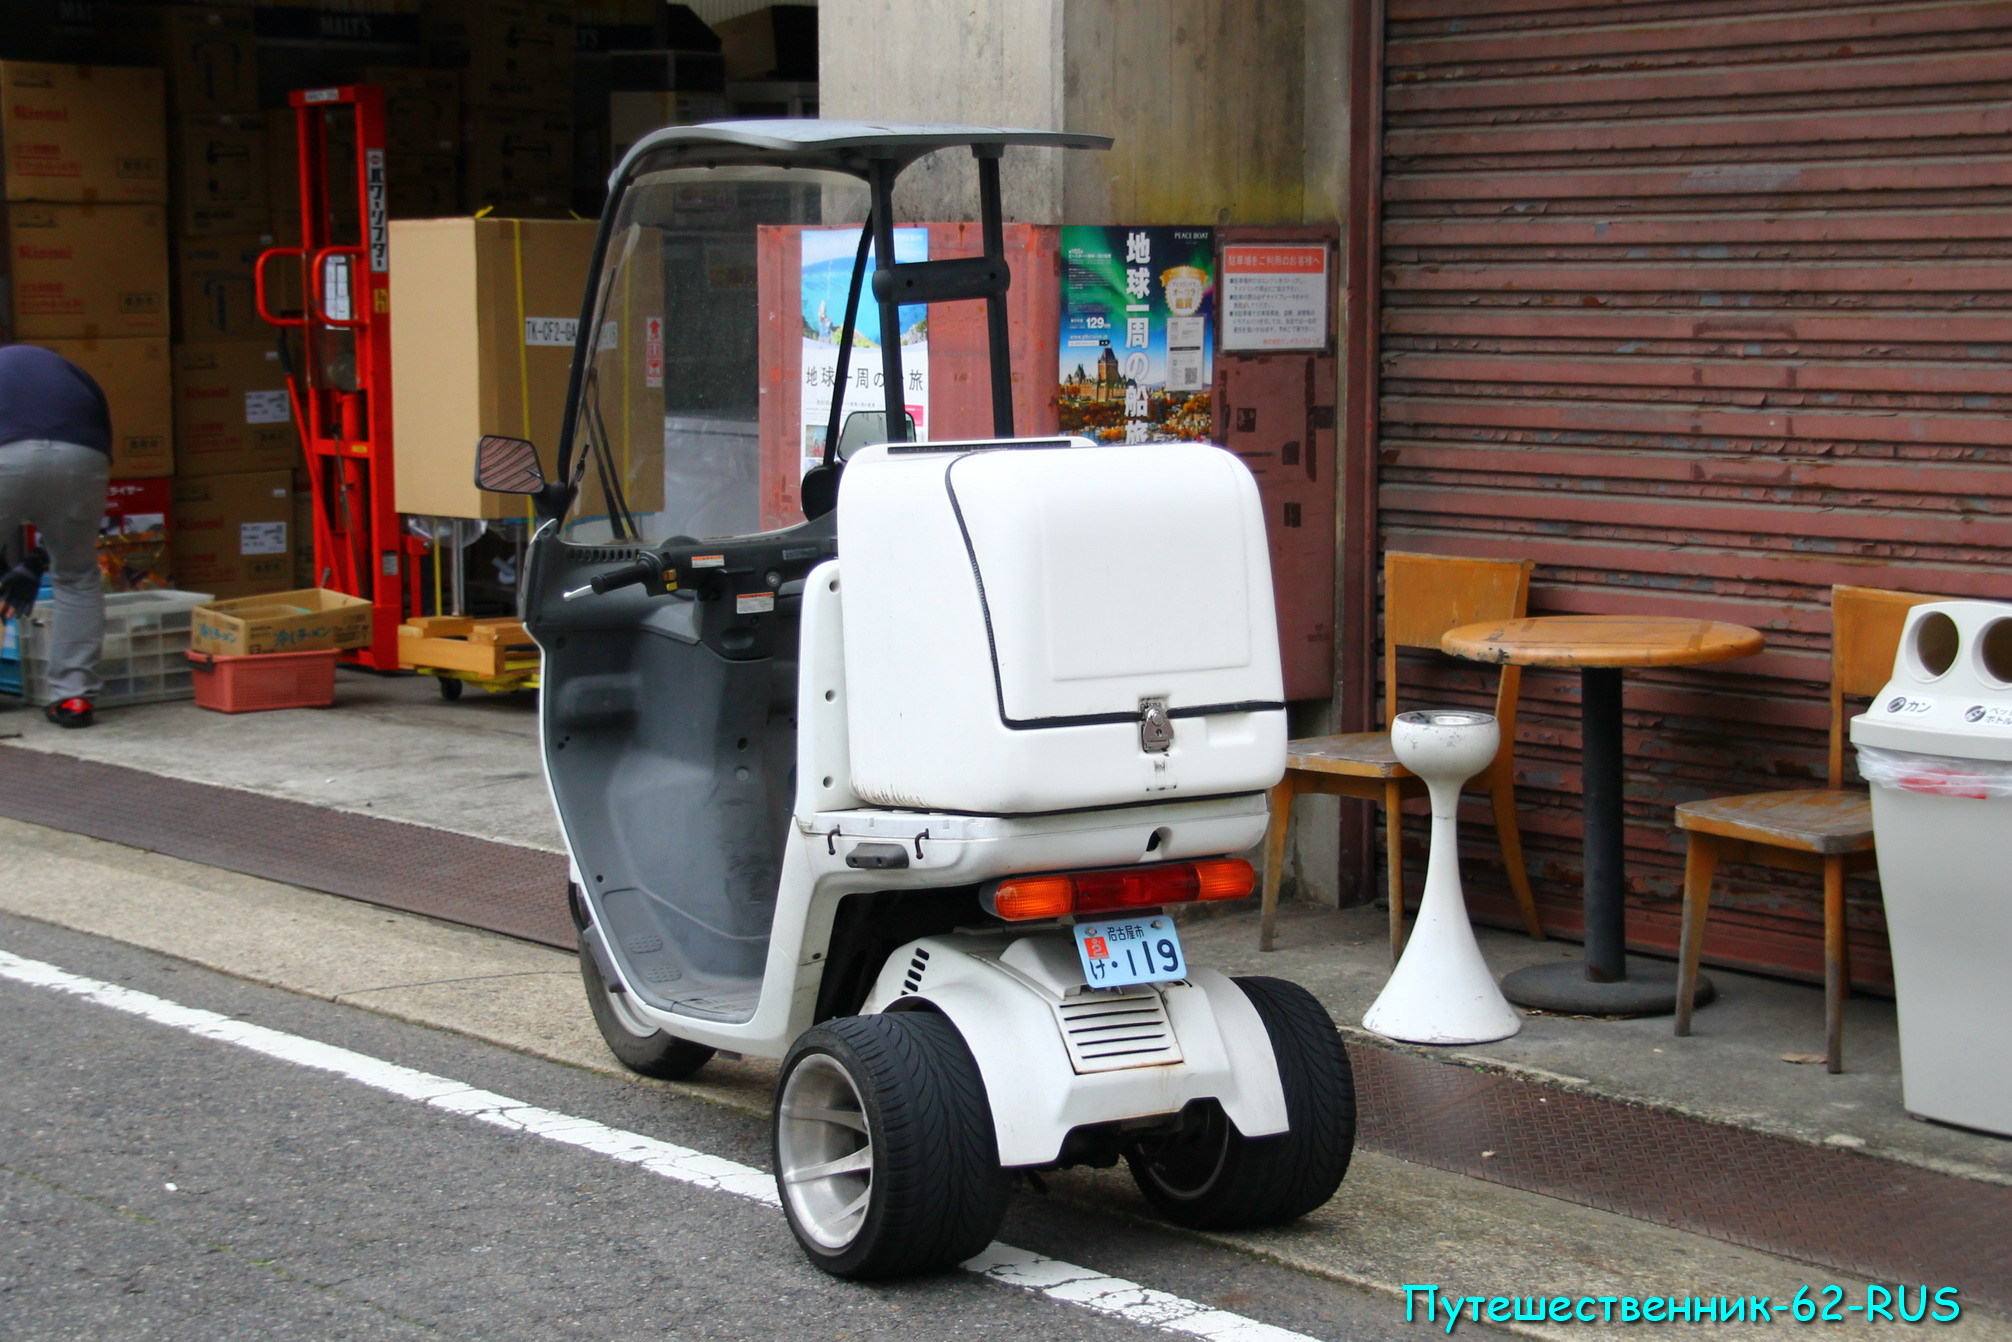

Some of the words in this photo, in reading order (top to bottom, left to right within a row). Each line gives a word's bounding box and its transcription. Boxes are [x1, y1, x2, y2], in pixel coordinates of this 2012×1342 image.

[1125, 232, 1151, 444] 地球一周の船旅
[805, 365, 924, 392] 地球周の旅
[1904, 700, 1932, 714] カン
[1107, 924, 1145, 942] 名古屋市
